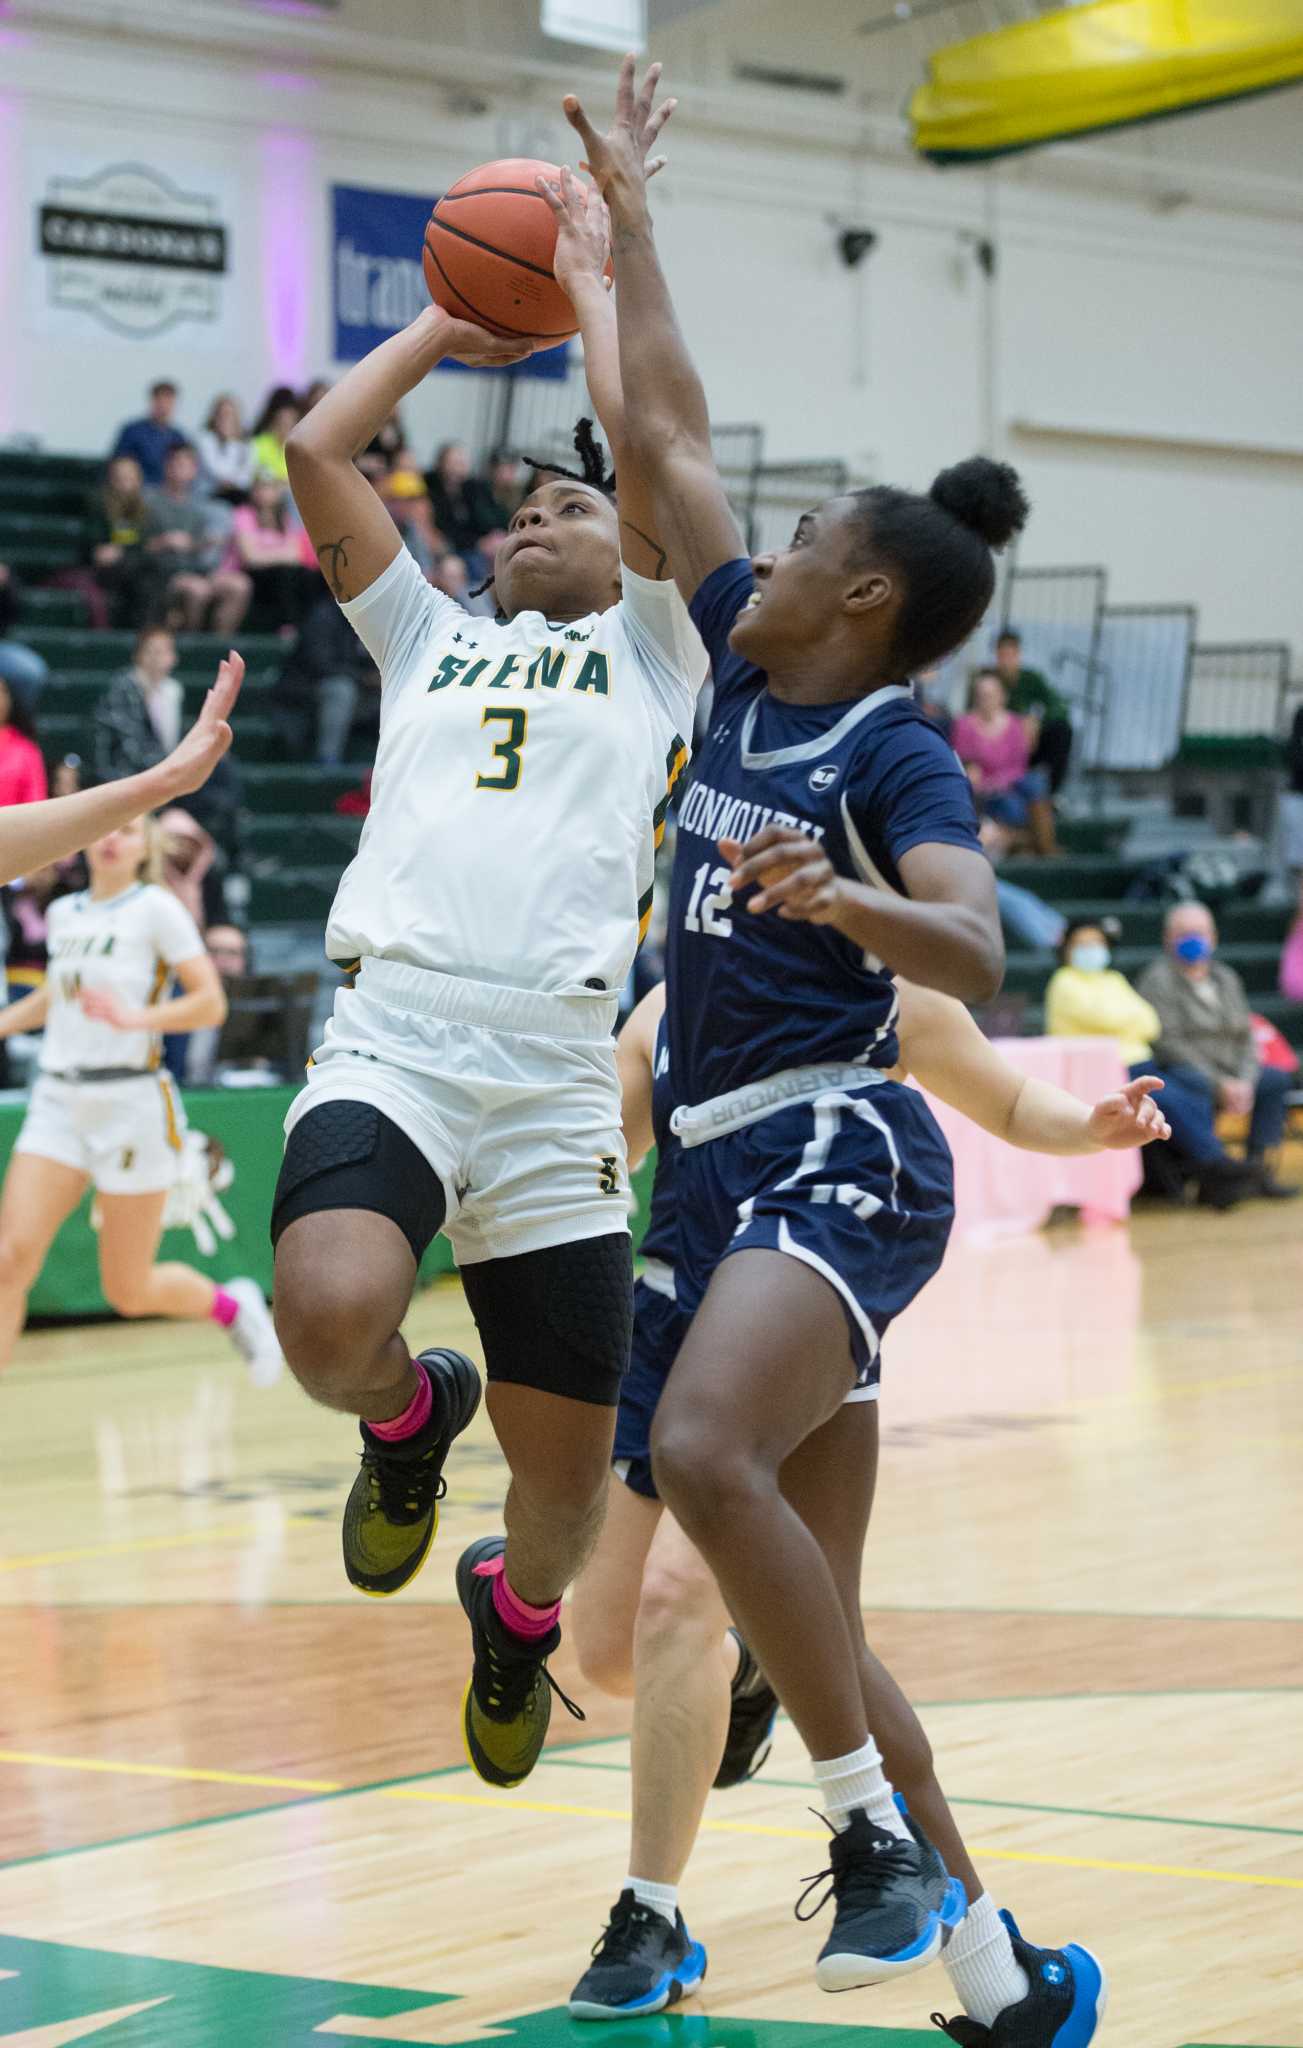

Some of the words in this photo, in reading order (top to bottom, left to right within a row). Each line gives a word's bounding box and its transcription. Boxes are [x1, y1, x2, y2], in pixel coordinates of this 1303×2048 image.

[426, 645, 612, 698] SIENA
[476, 705, 528, 792] 3
[684, 862, 733, 938] 12
[710, 1070, 844, 1126] ARMOUR
